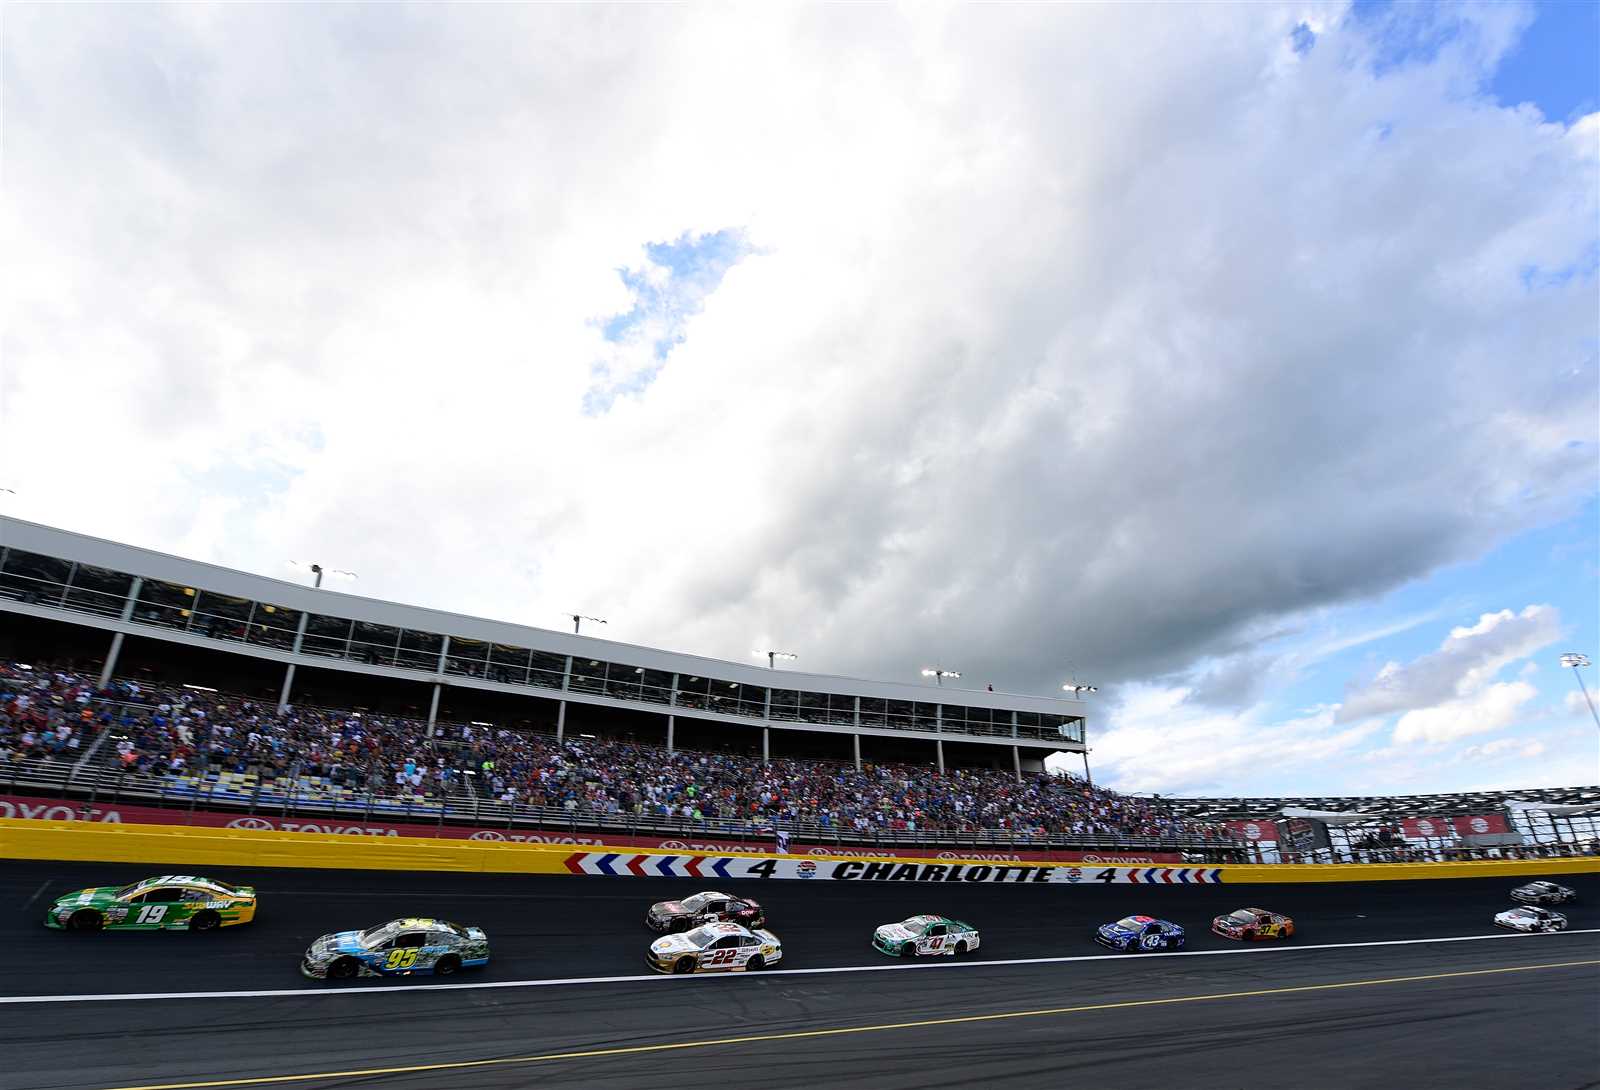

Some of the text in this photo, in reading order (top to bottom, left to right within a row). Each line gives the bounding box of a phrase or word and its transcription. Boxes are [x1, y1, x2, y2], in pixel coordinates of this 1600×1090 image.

[746, 859, 777, 879] 4
[831, 861, 1056, 883] CHARLOTTE
[1095, 868, 1117, 883] 4
[136, 905, 169, 924] 19
[183, 901, 232, 910] SUBWAY
[384, 948, 419, 969] 95
[711, 949, 738, 965] 22
